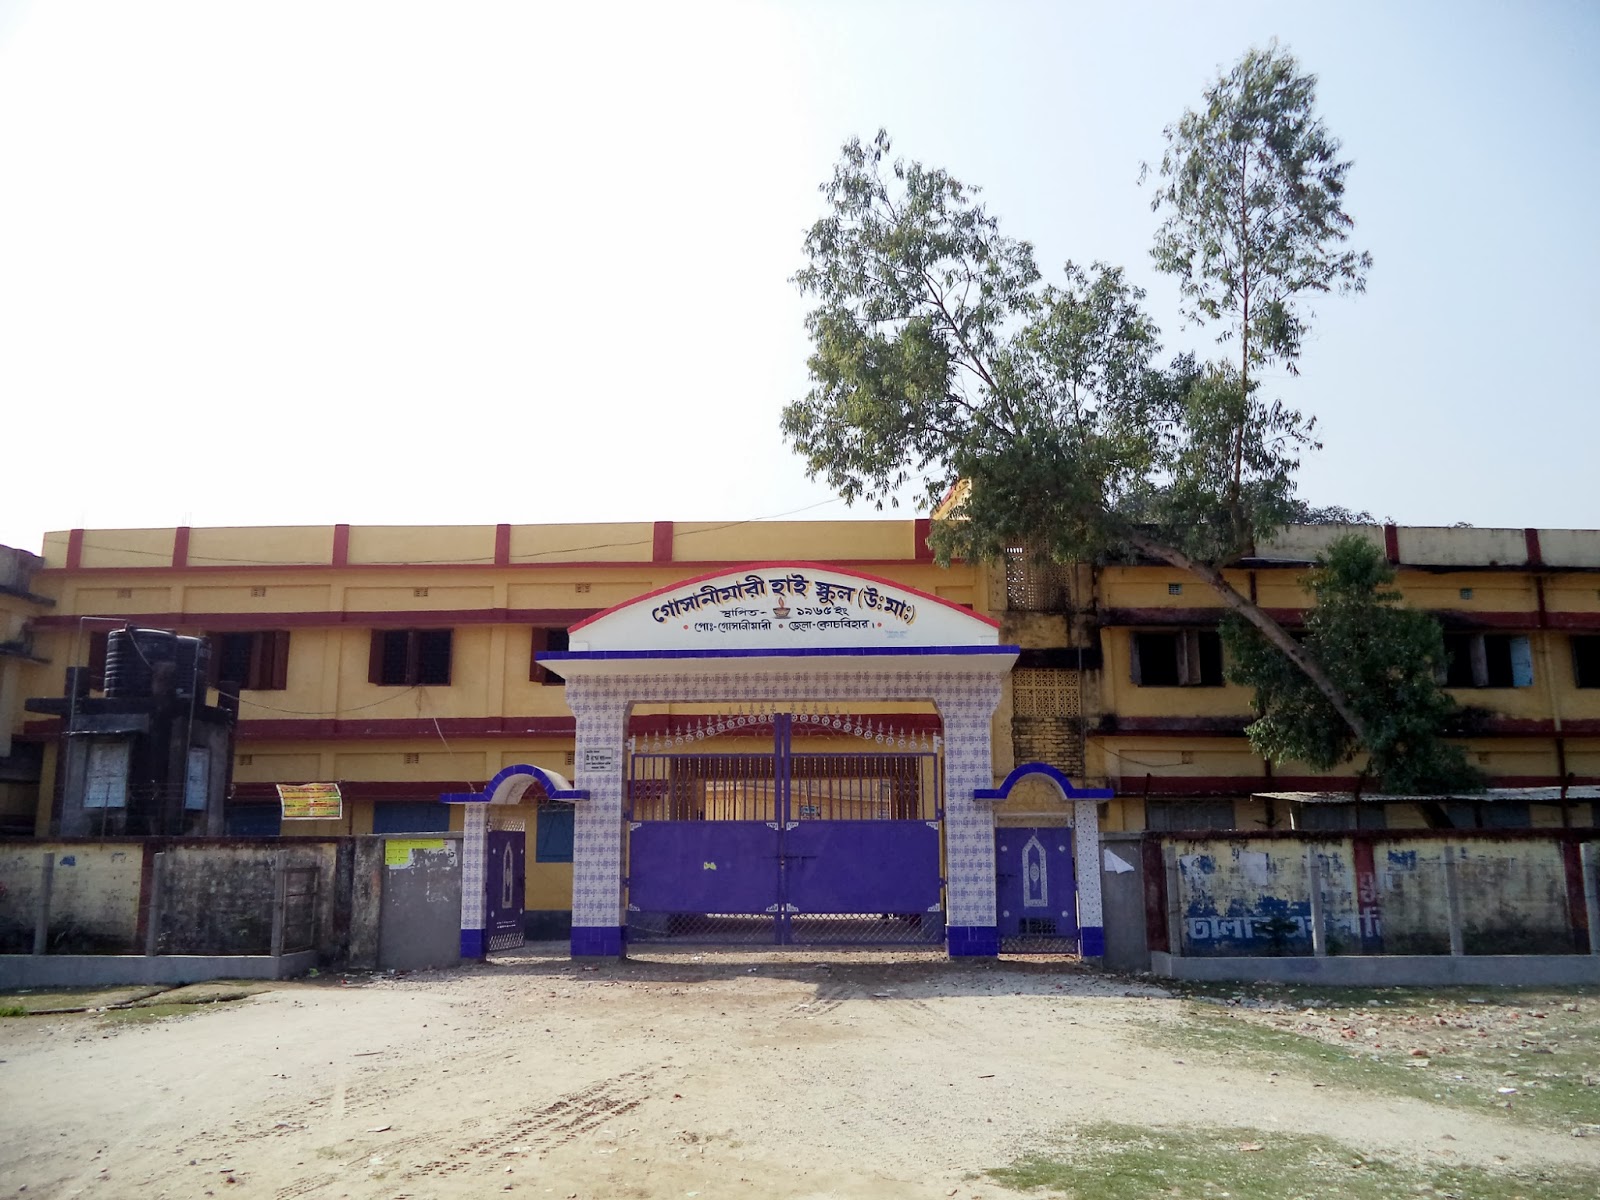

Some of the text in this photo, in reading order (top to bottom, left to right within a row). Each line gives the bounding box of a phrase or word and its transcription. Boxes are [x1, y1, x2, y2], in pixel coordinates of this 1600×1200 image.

[652, 575, 766, 623] গোসানীমারী
[769, 573, 810, 597] হাই
[815, 581, 855, 605] স্কুল
[797, 606, 832, 616] ১৯৬৫
